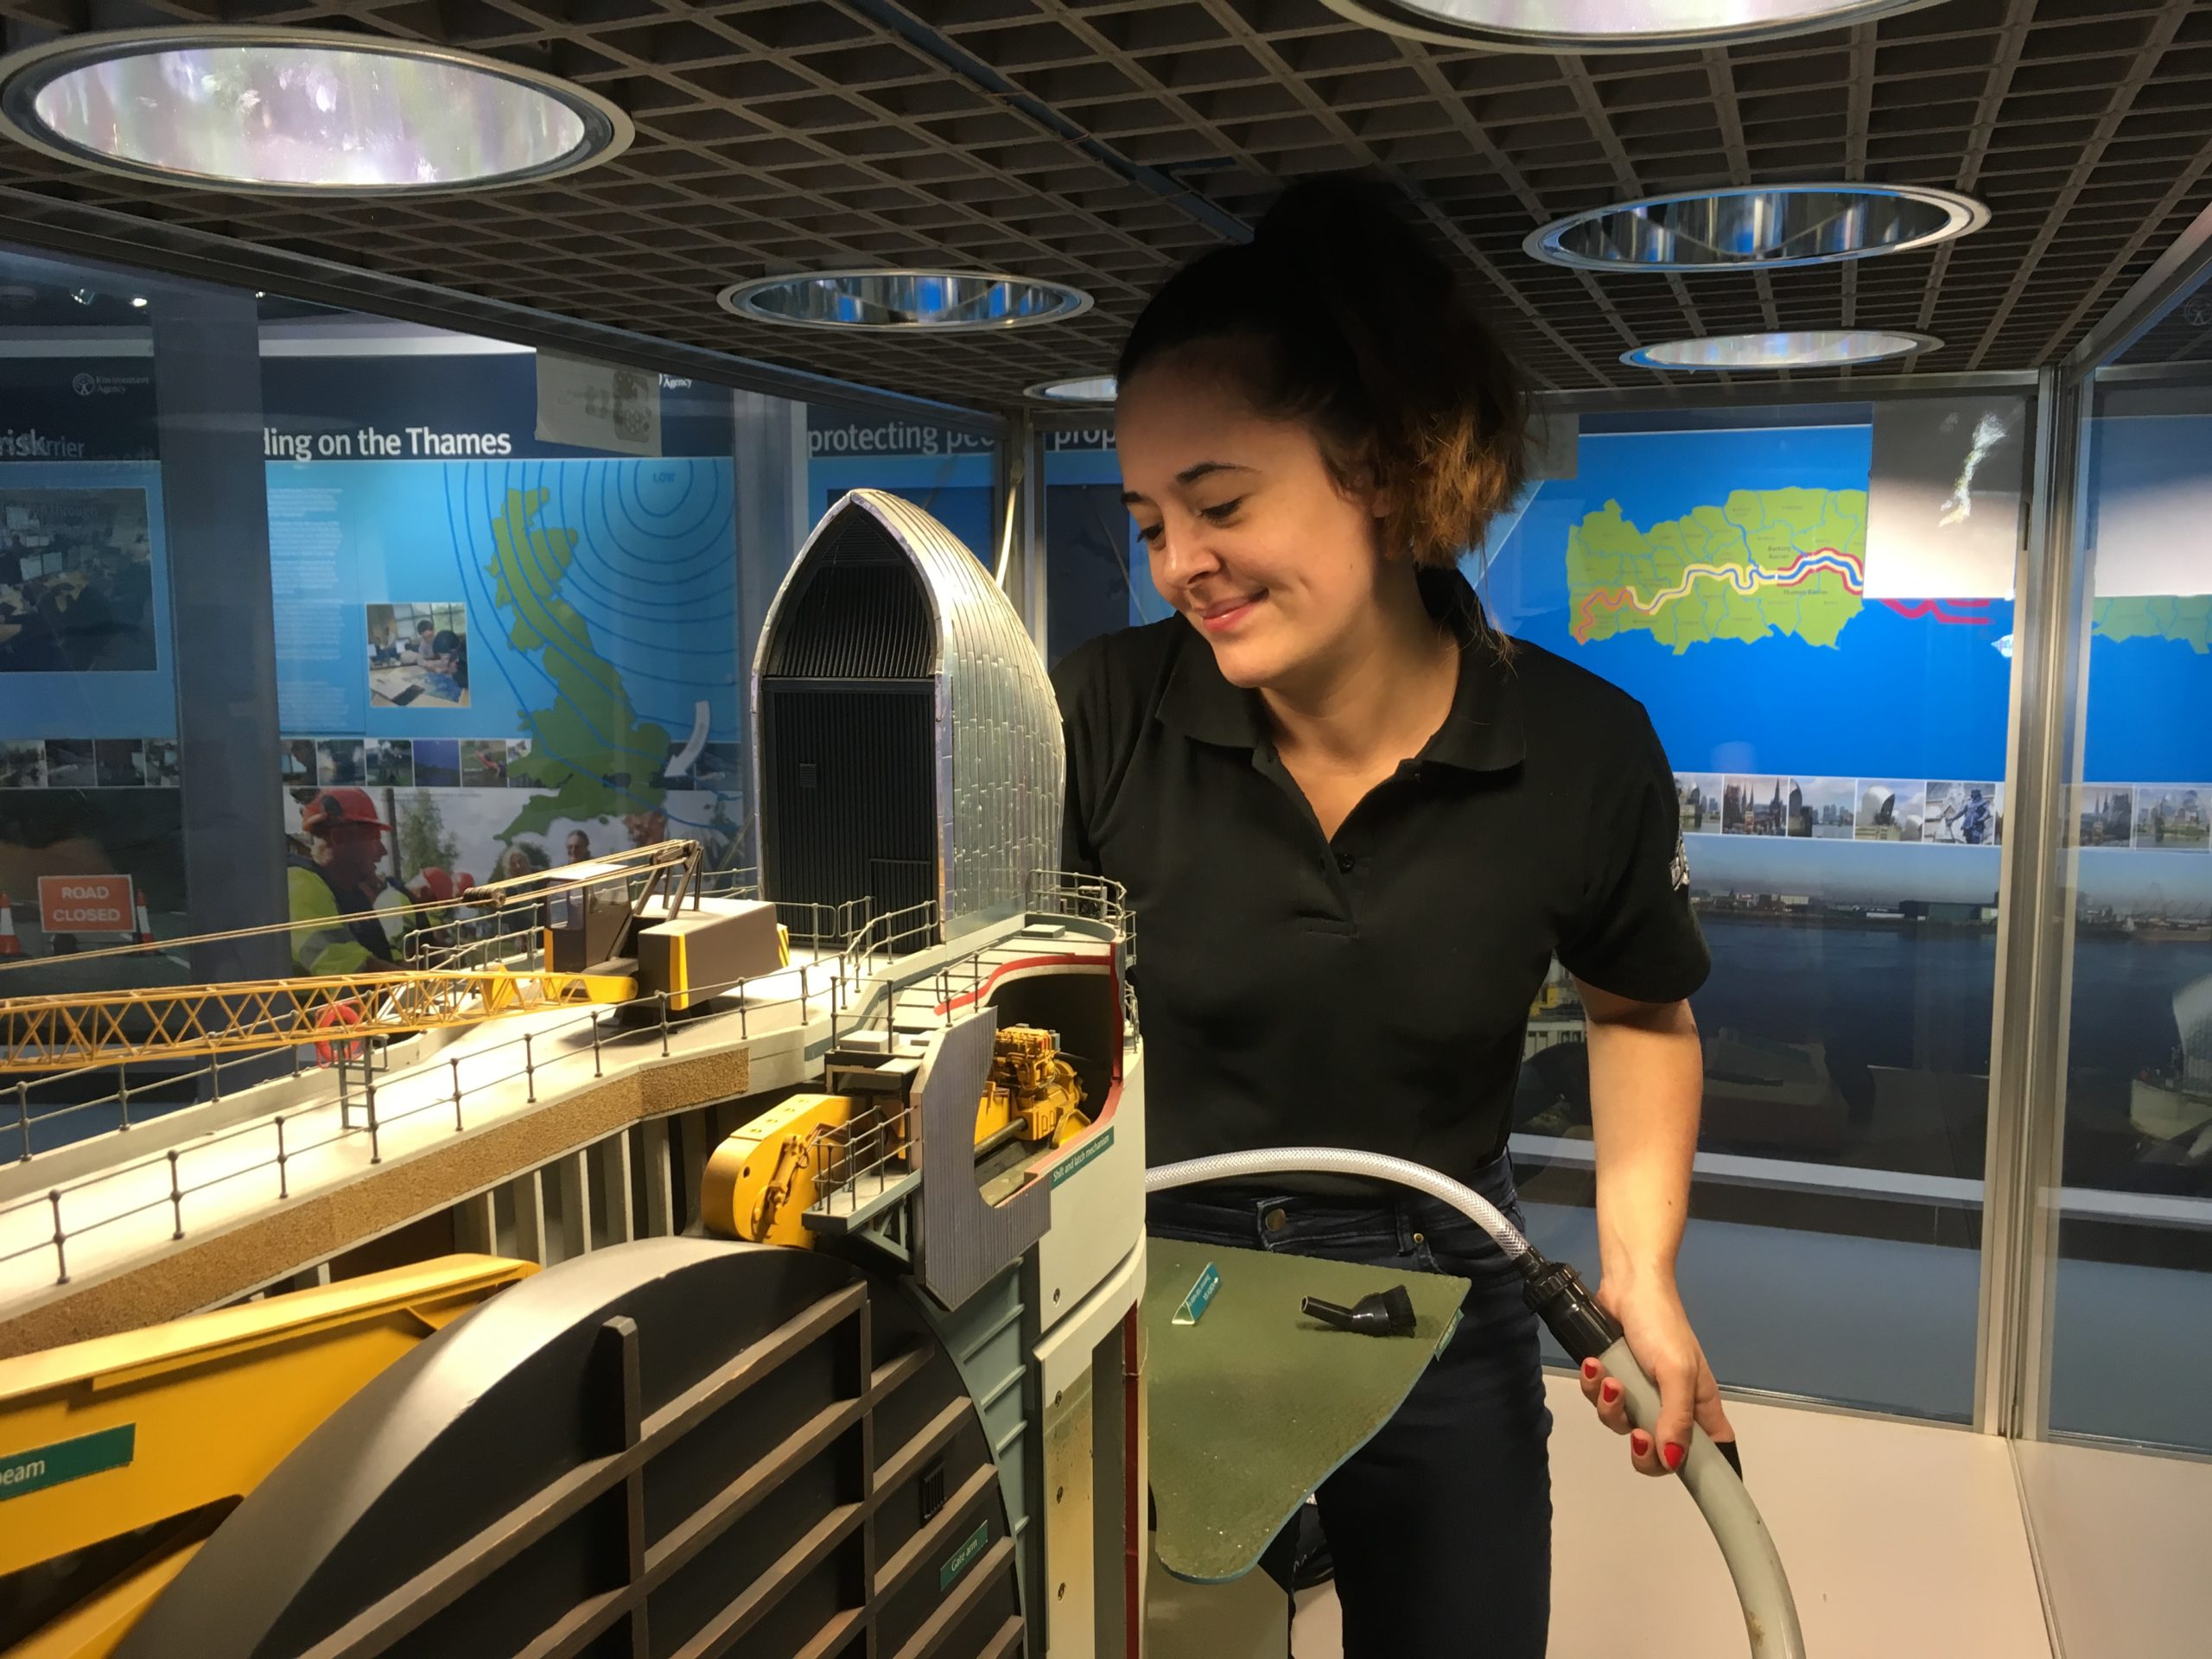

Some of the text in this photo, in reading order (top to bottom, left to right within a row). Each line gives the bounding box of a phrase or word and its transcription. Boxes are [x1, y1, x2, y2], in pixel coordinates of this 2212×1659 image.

[663, 378, 693, 389] Agency
[318, 433, 351, 456] on
[358, 427, 402, 456] the
[405, 427, 512, 456] Thames
[808, 421, 939, 459] protecting
[652, 472, 676, 483] LOW
[61, 886, 110, 899] ROAD
[53, 908, 121, 922] CLOSED
[1065, 1158, 1074, 1174] and
[1074, 1150, 1086, 1167] latch
[1085, 1135, 1109, 1158] mechanism
[0, 1459, 45, 1484] eam
[951, 1539, 978, 1572] Gate arm
